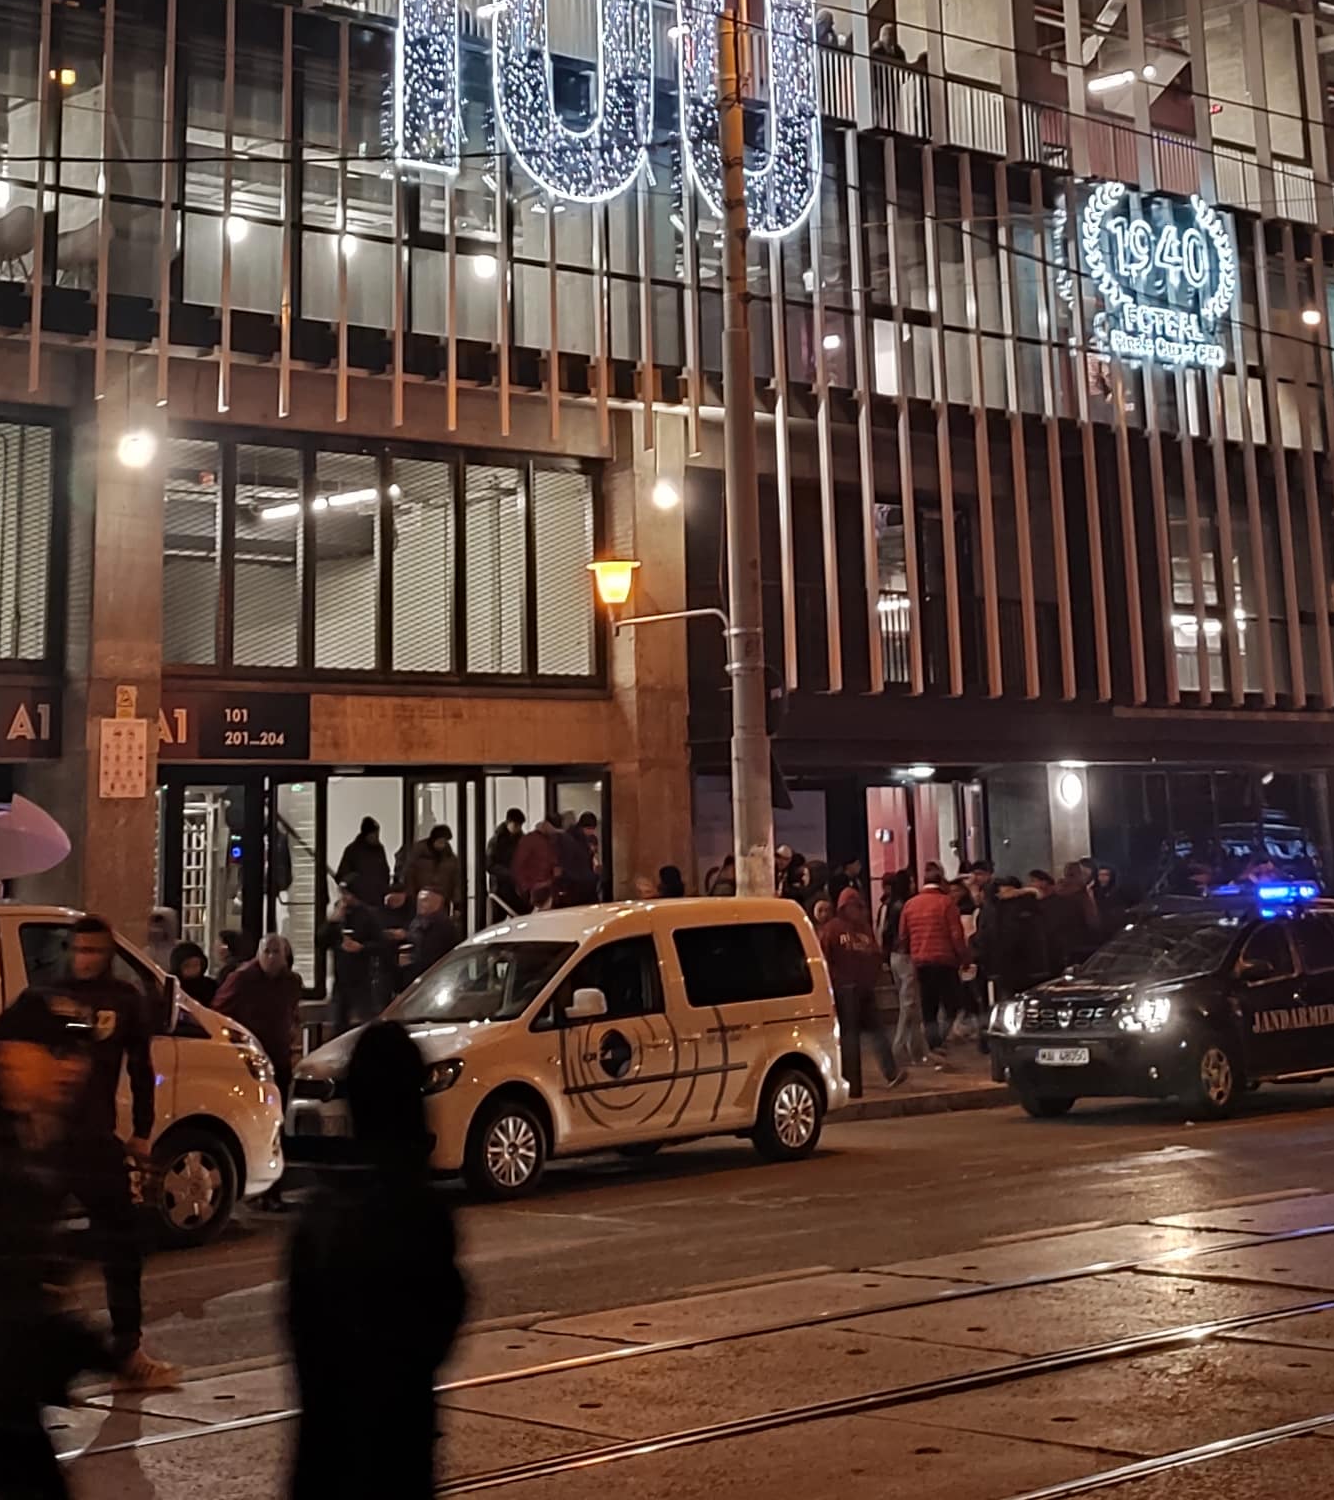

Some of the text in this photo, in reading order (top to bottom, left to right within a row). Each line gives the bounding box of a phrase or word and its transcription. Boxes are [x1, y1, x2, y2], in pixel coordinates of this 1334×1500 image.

[1106, 216, 1209, 288] 1940
[6, 702, 50, 740] A1
[224, 708, 248, 722] 101
